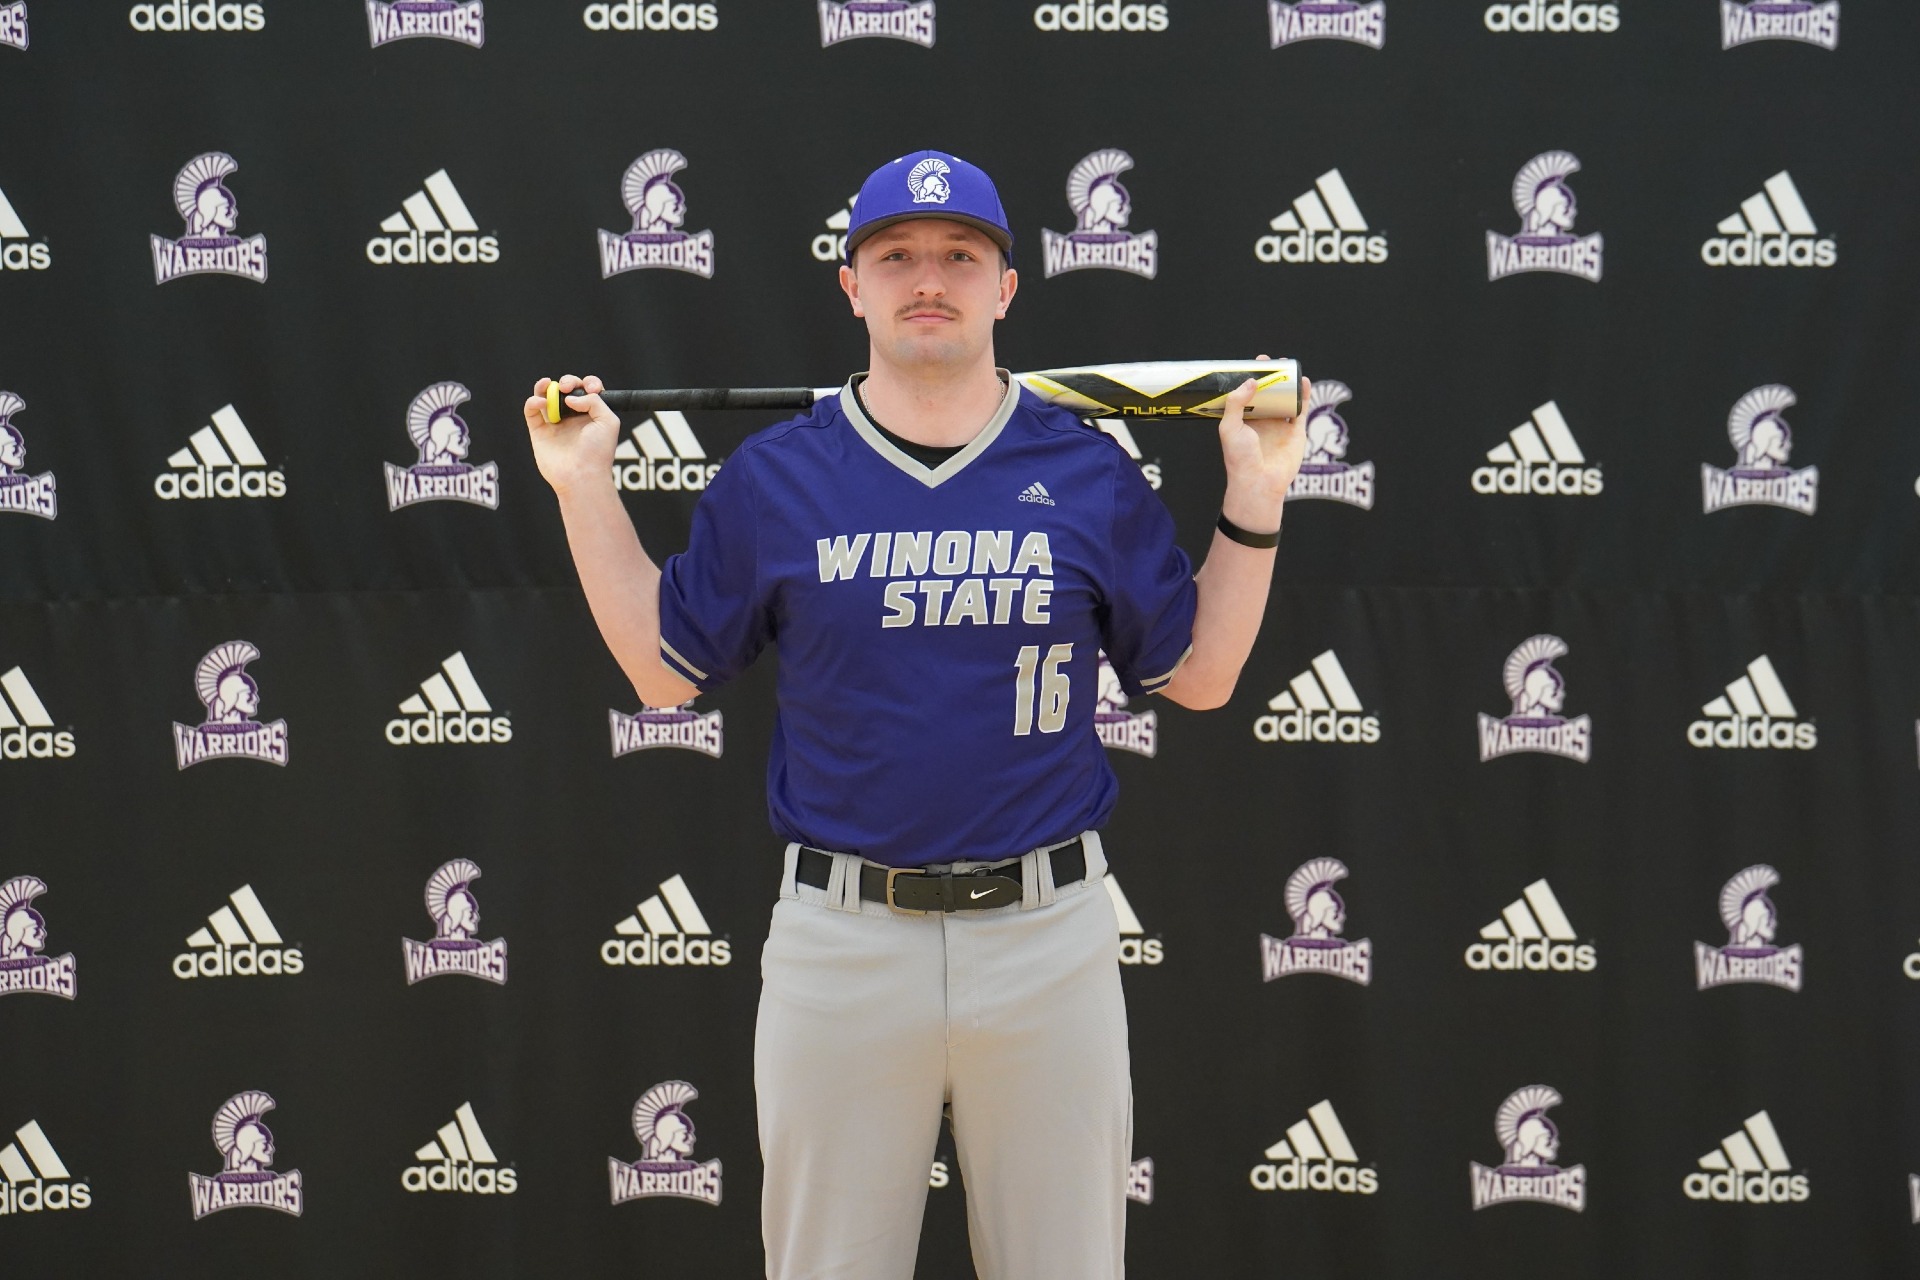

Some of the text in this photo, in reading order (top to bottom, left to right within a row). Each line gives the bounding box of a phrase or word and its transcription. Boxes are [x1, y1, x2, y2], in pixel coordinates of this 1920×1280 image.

[130, 0, 265, 31] adidas
[368, 0, 482, 45] WARRIORS
[584, 0, 718, 30] adidas
[820, 0, 933, 45] WARRIORS
[1035, 0, 1168, 31] adidas
[1270, 2, 1383, 46] WARRIORS
[1485, 0, 1619, 31] adidas
[1723, 2, 1837, 47] WARRIORS
[153, 237, 265, 281] WARRIORS
[182, 239, 214, 247] WINONA
[367, 231, 499, 264] adidas
[600, 232, 711, 275] WARRIORS
[1044, 232, 1155, 276] WARRIORS
[1256, 229, 1388, 262] adidas
[1488, 234, 1601, 279] WARRIORS
[1702, 232, 1836, 266] adidas
[1123, 406, 1182, 415] NUKE
[155, 465, 286, 499] adidas
[386, 464, 497, 508] WARRIORS
[1472, 461, 1603, 494] adidas
[1704, 467, 1816, 512] WARRIORS
[1018, 493, 1055, 507] adidas
[816, 530, 1054, 583] WINONA
[882, 578, 1054, 628] STATE
[1013, 642, 1074, 736] 16
[203, 723, 258, 732] WINONA STATE
[386, 710, 512, 744] adidas
[611, 713, 720, 754] WARRIORS
[1255, 710, 1380, 742] adidas
[1480, 716, 1588, 759] WARRIORS
[1688, 715, 1816, 748] adidas
[176, 722, 286, 766] WARRIORS
[24, 959, 44, 967] STATE
[173, 943, 303, 978] adidas
[405, 940, 504, 981] WARRIORS
[602, 931, 731, 964] adidas
[1263, 937, 1369, 982] WARRIORS
[1466, 937, 1596, 970] adidas
[1697, 945, 1800, 988] WARRIORS
[220, 1173, 273, 1182] WINONA STATE
[403, 1159, 517, 1193] adidas
[611, 1160, 719, 1202] WARRIORS
[1251, 1158, 1377, 1193] adidas
[1473, 1166, 1583, 1208] WARRIORS
[1684, 1168, 1809, 1202] adidas
[0, 1178, 91, 1216] idas
[192, 1172, 300, 1216] WARRIORS
